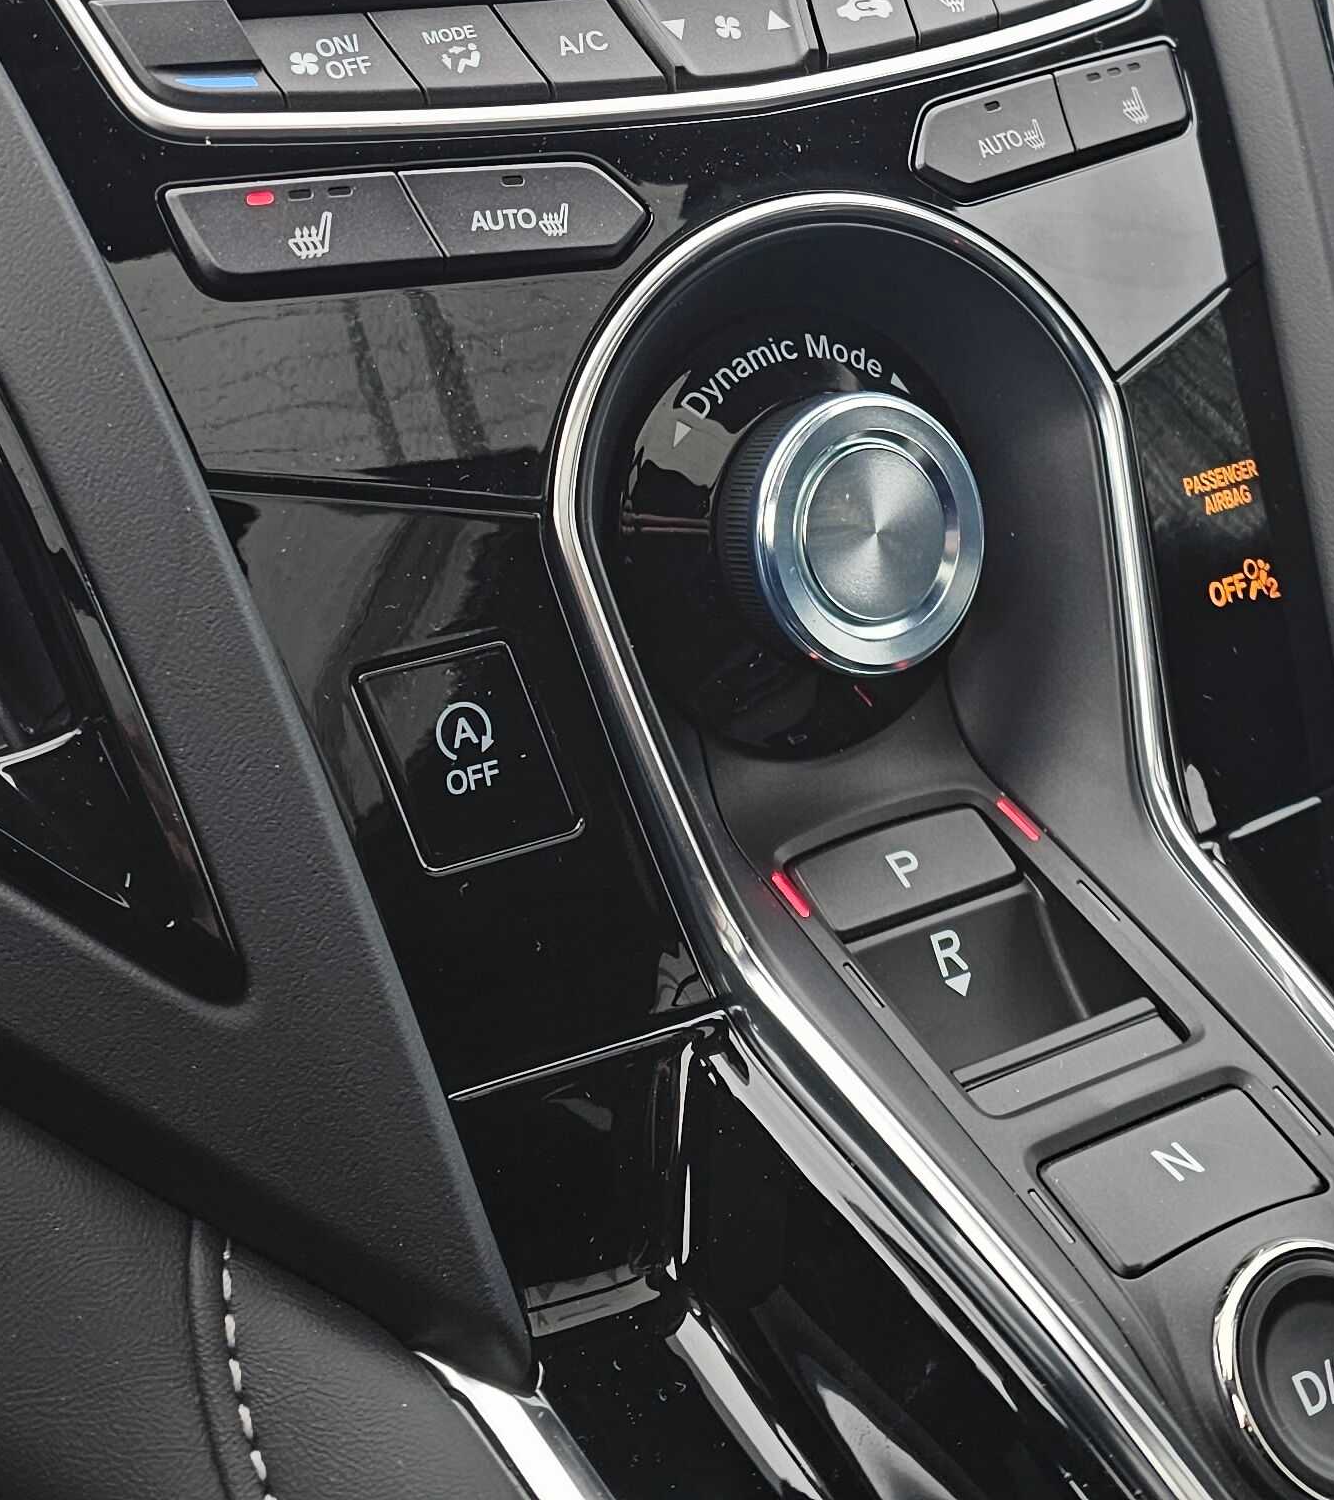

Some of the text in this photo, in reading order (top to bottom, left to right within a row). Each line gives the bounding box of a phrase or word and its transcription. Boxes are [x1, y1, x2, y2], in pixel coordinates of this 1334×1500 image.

[316, 33, 359, 58] ON/
[422, 24, 478, 46] MODE
[558, 30, 609, 57] A/C
[325, 55, 372, 81] OFF
[978, 131, 1023, 158] AUTO
[471, 208, 536, 232] AUTO
[681, 333, 882, 420] Dynamic Mode
[1183, 459, 1259, 497] PASSENGER
[1204, 484, 1252, 516] AIRBAG
[1208, 572, 1247, 608] OFF
[446, 760, 499, 795] OFF
[885, 850, 919, 889] P
[930, 929, 969, 977] R
[1150, 1142, 1205, 1181] N
